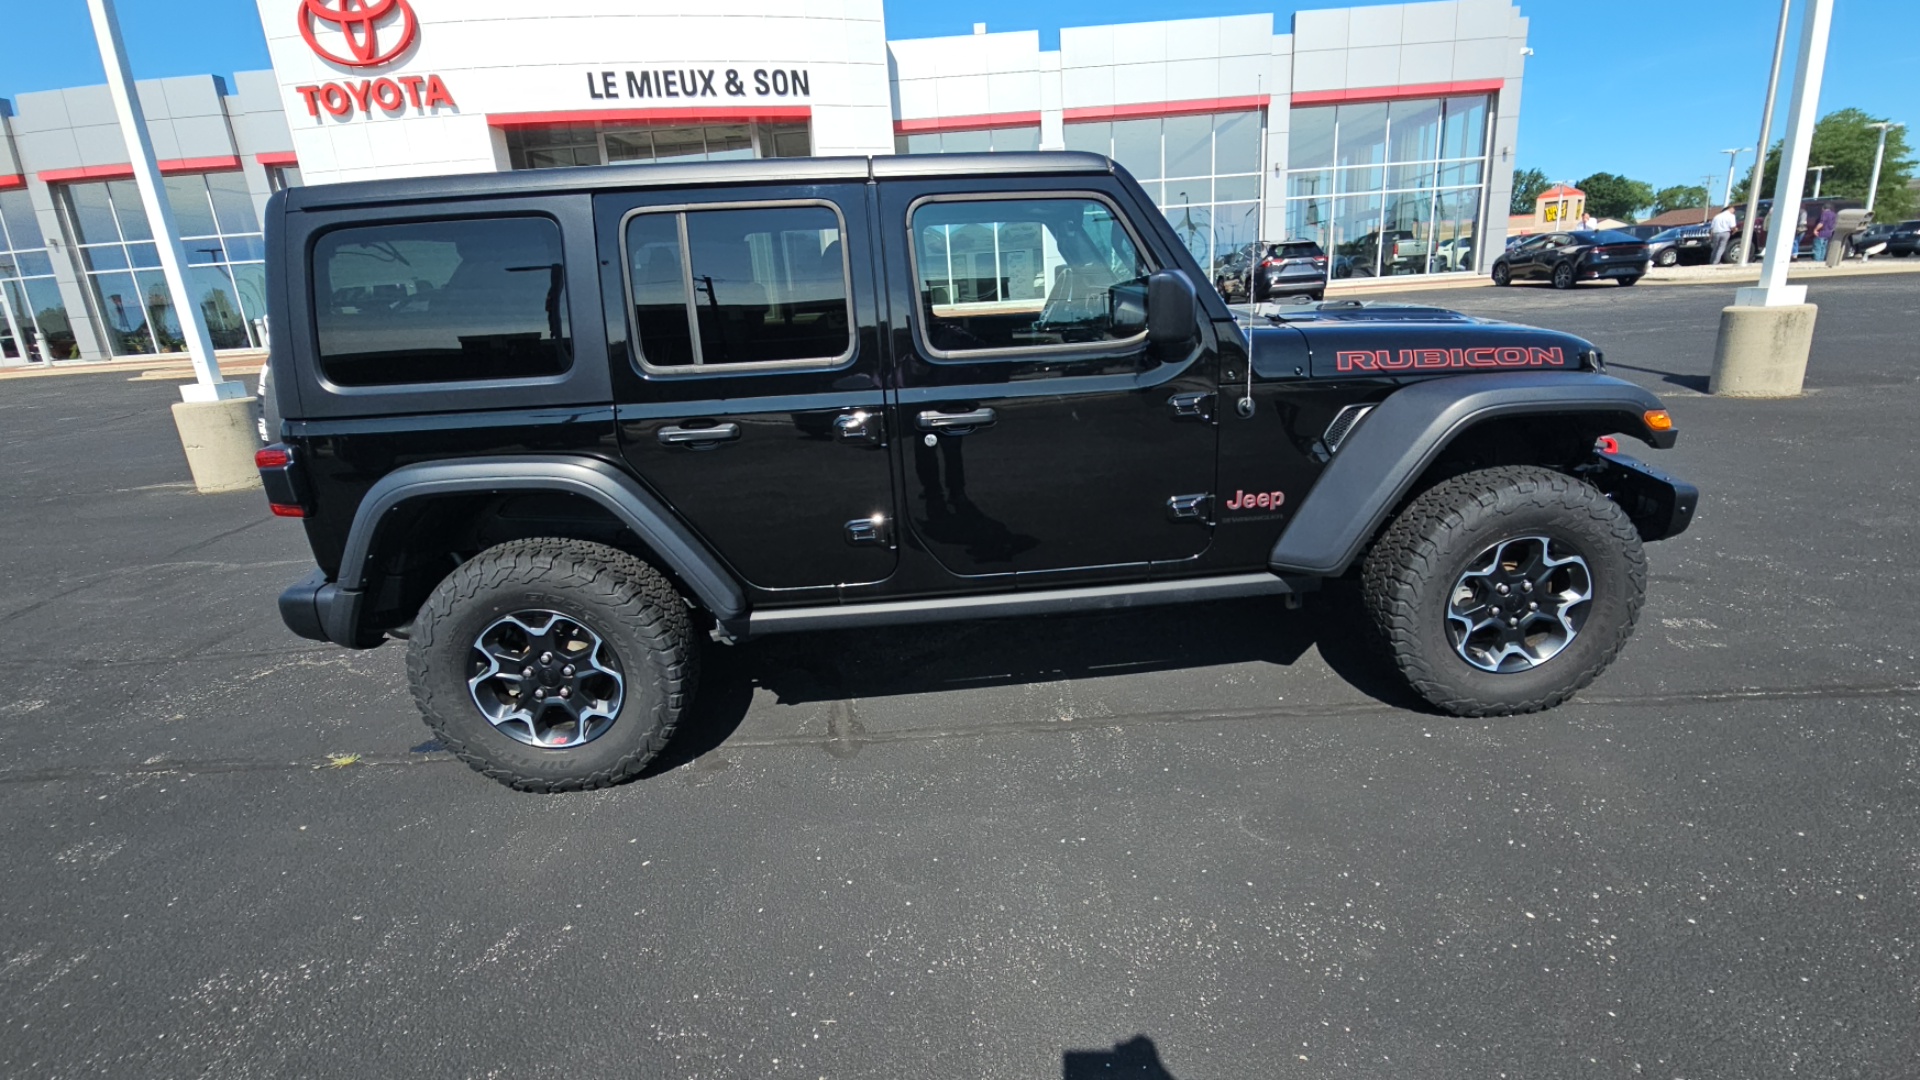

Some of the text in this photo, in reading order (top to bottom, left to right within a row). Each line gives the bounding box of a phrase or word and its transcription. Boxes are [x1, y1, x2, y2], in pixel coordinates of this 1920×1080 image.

[296, 74, 455, 117] TOYOTA
[586, 68, 811, 99] LE MIEUX & SON
[1336, 347, 1564, 371] RUBICON
[1226, 489, 1285, 511] Jeep
